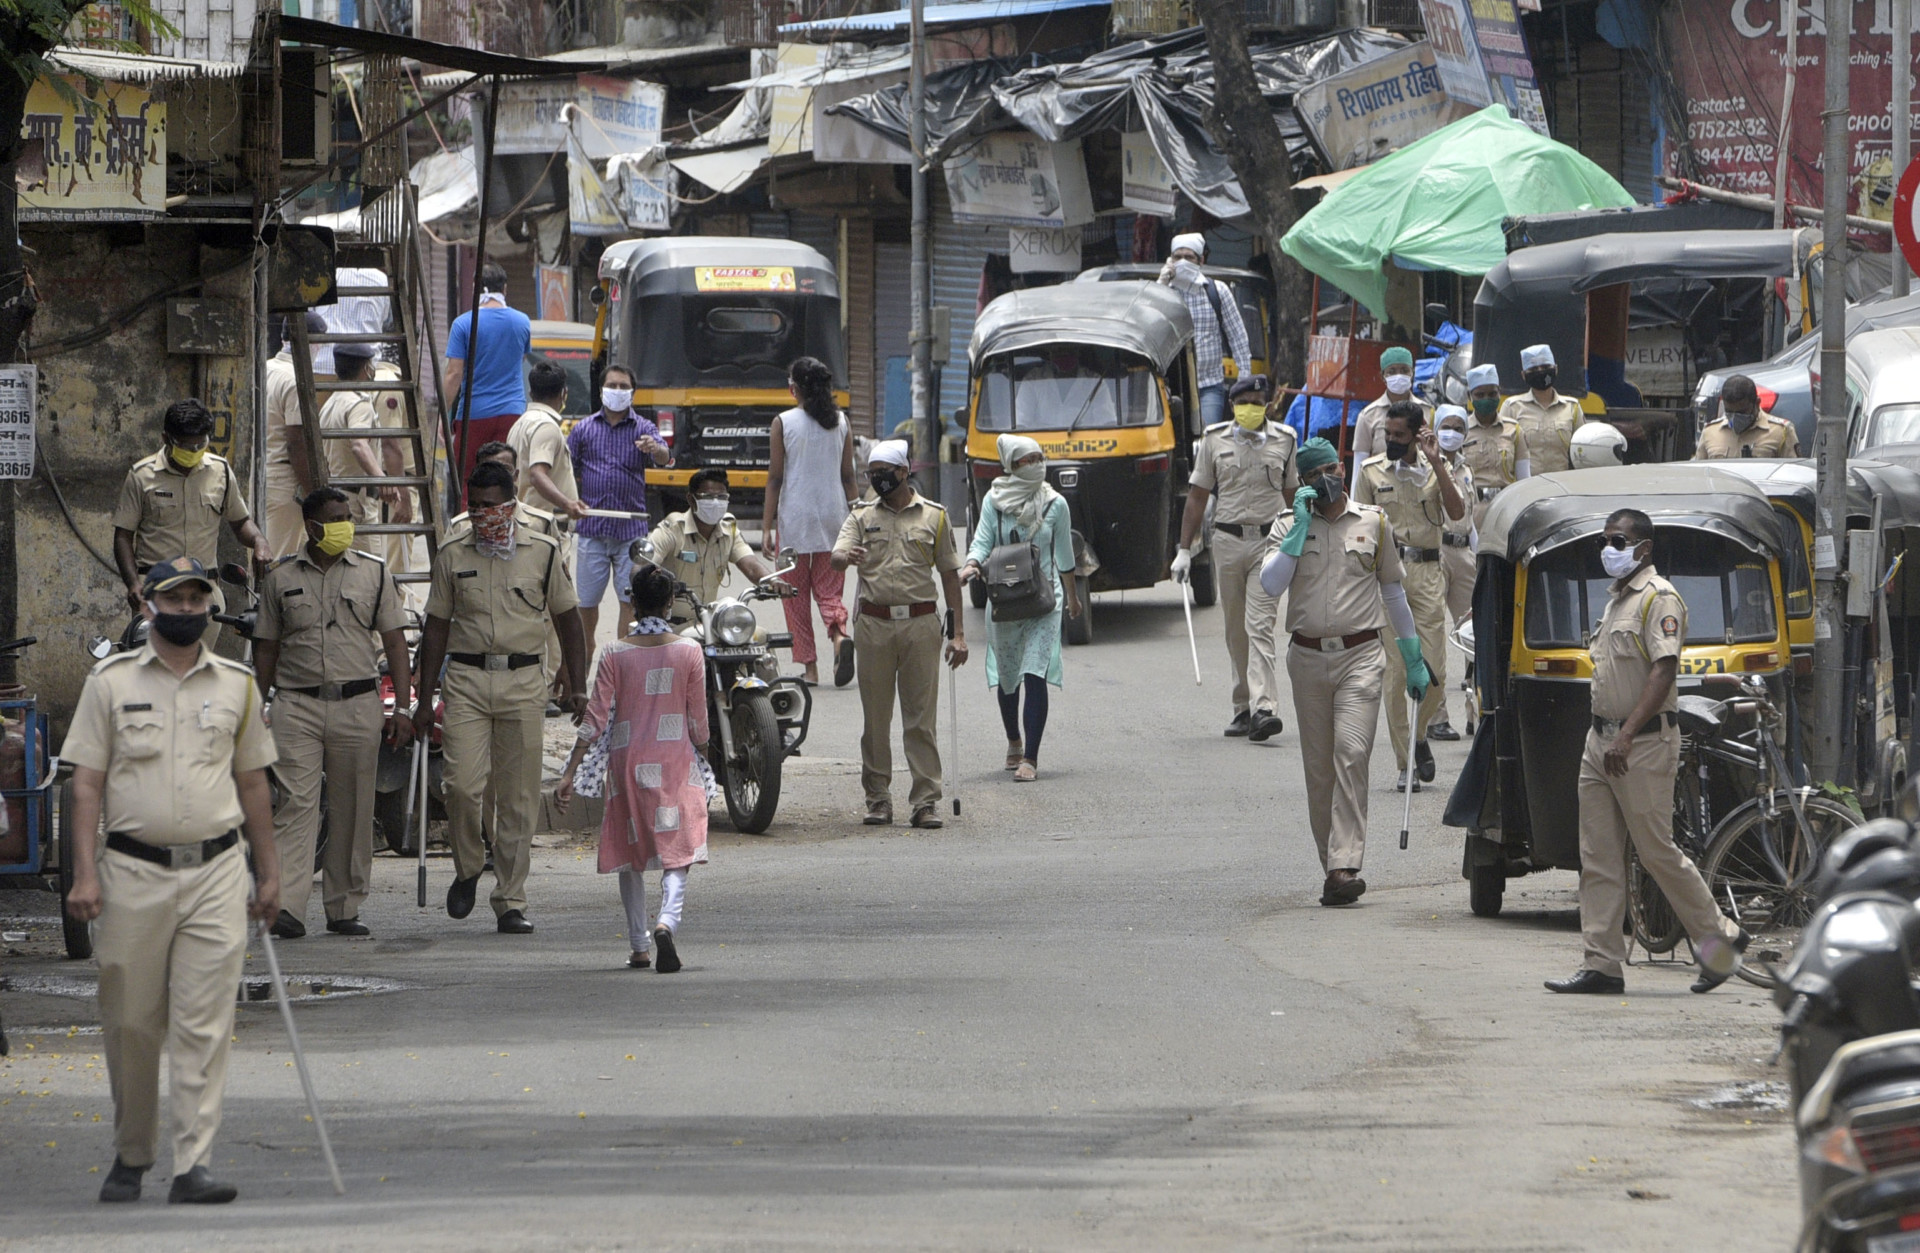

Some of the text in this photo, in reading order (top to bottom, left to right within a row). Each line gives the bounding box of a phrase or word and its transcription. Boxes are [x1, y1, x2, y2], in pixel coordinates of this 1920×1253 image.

[1403, 61, 1444, 98] रहिव
[1013, 229, 1080, 255] XEROX
[1625, 347, 1684, 364] VELRY
